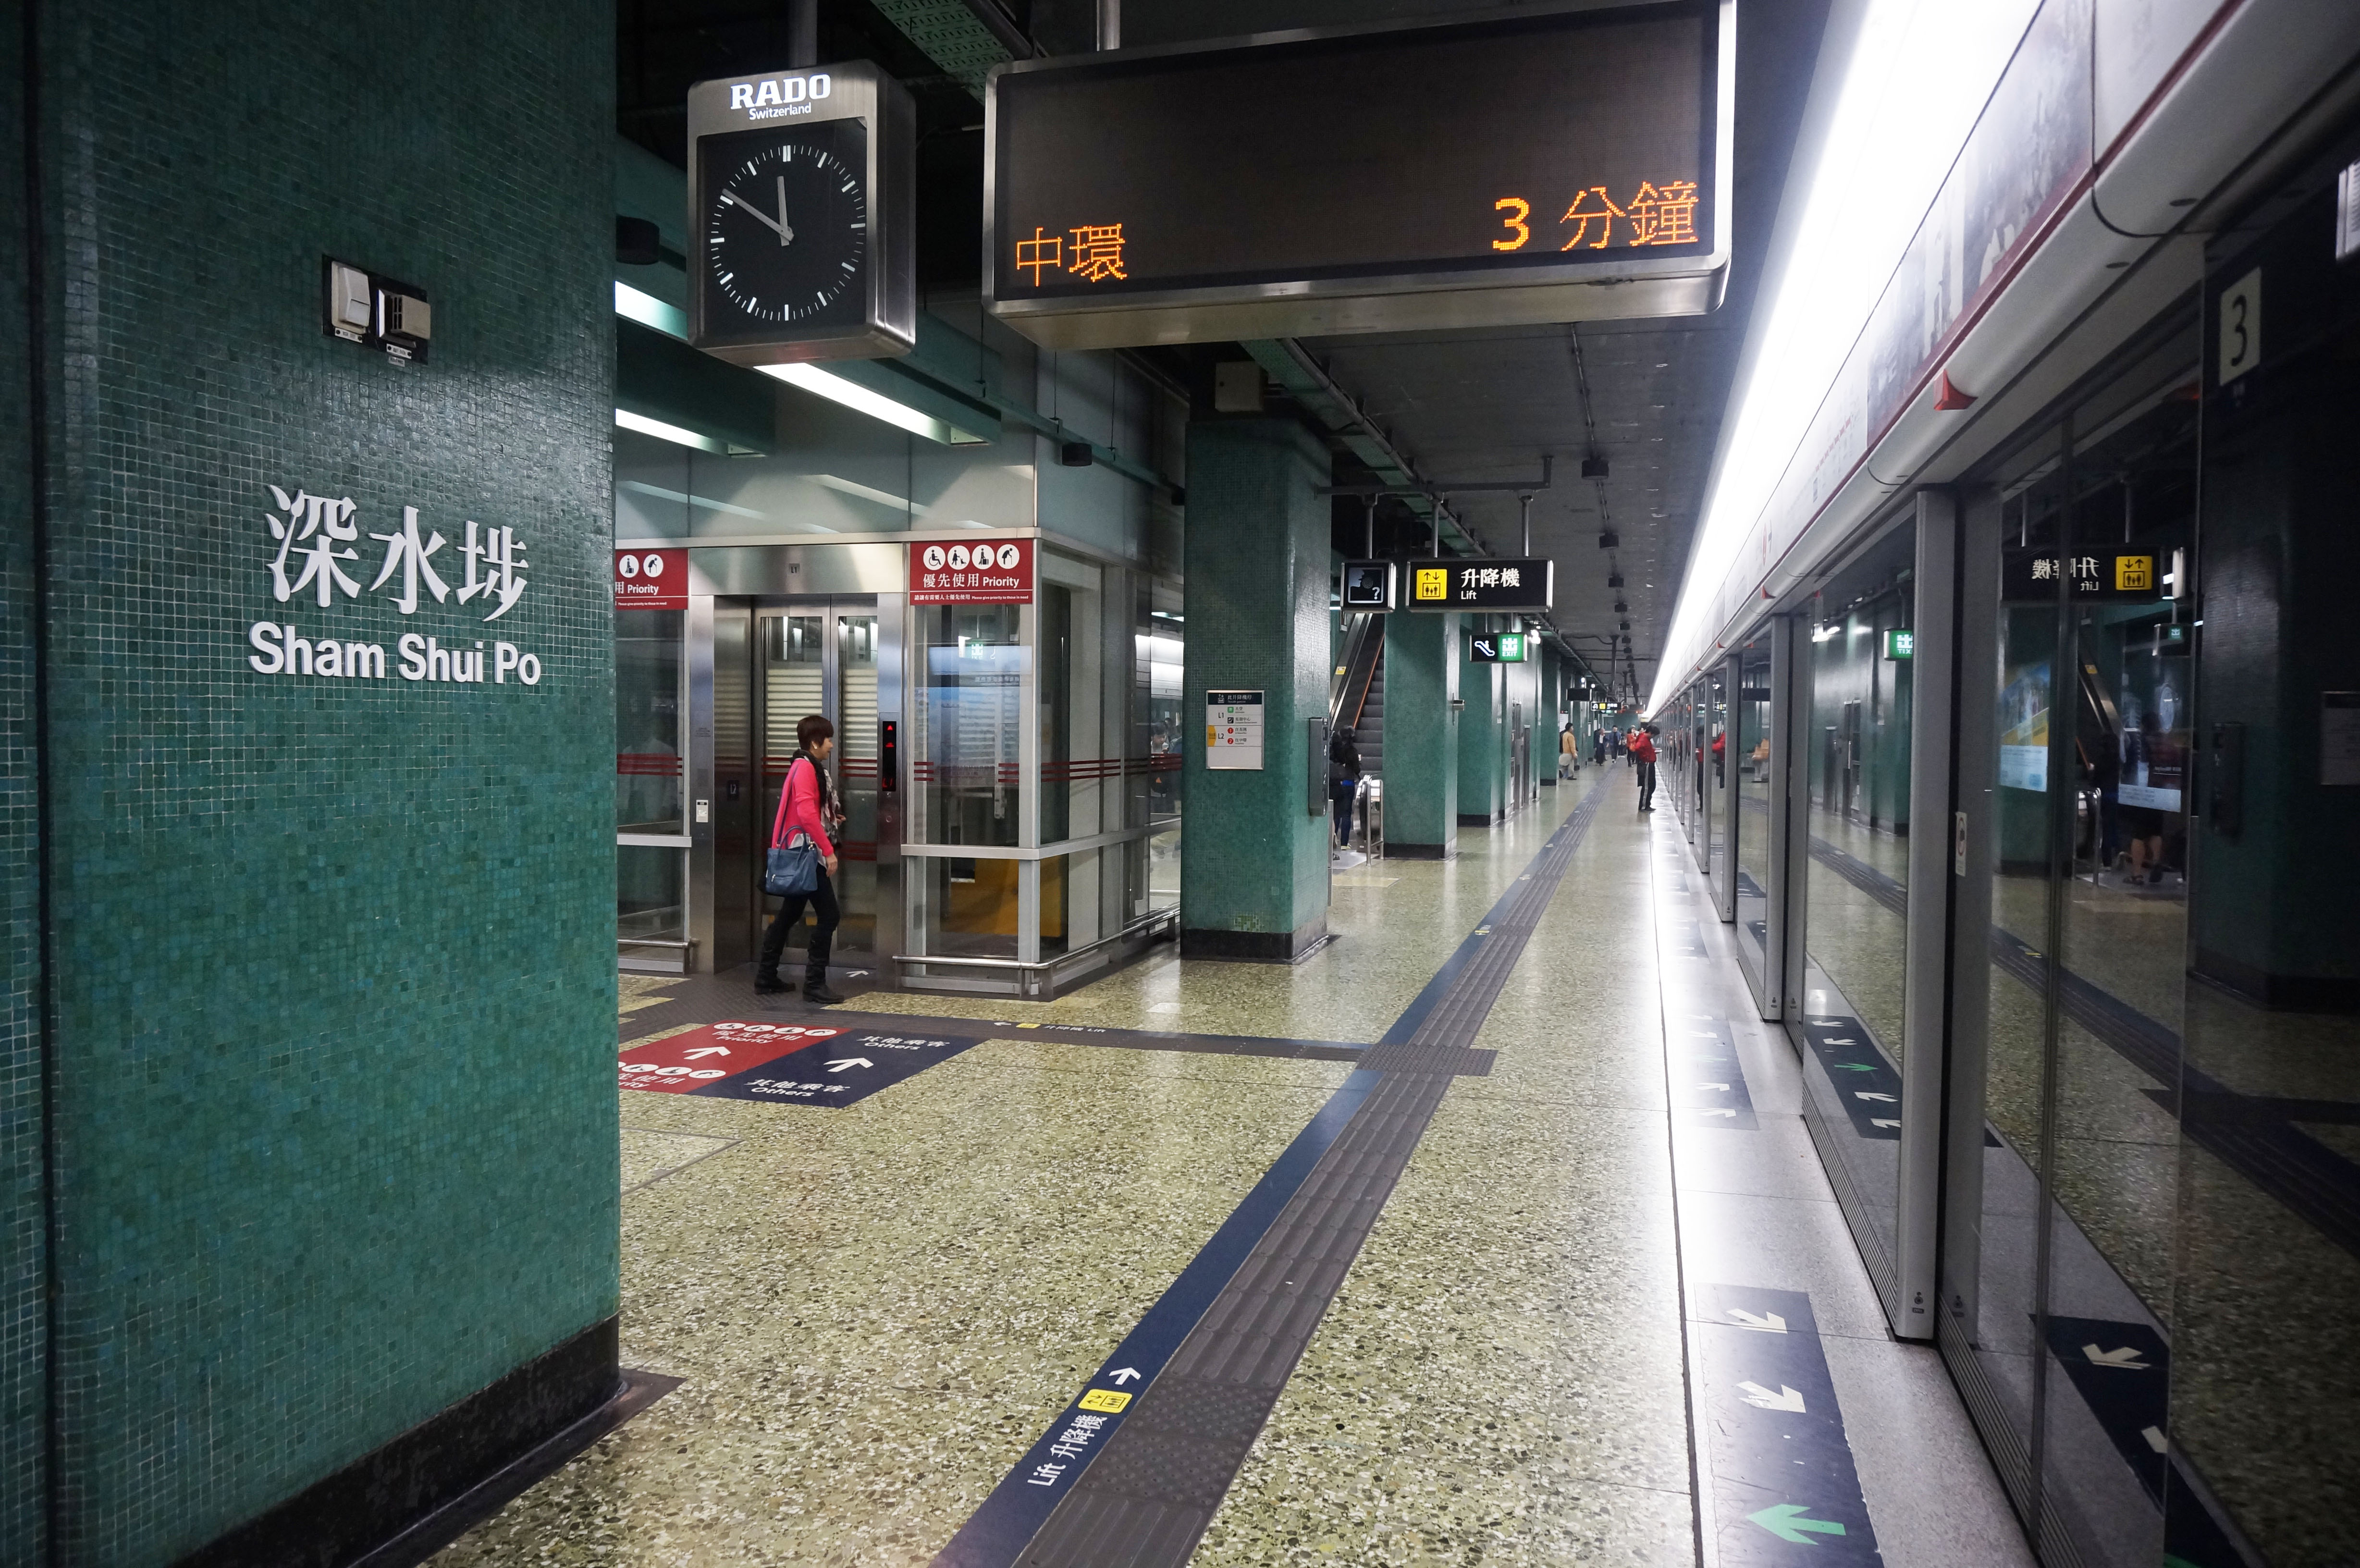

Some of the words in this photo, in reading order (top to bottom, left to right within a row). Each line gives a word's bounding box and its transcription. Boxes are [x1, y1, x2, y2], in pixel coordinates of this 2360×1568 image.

[730, 74, 831, 110] RADO
[749, 102, 811, 121] Switzerland
[1016, 222, 1127, 287] 中環
[1493, 197, 1530, 250] 3
[1560, 181, 1699, 252] 分鐘
[2231, 294, 2248, 368] 3
[264, 484, 529, 622] 深水埗
[923, 573, 980, 588] 優先使用
[983, 576, 1020, 588] Priority
[1460, 567, 1520, 588] 升降機
[627, 584, 659, 596] Priority
[1461, 590, 1477, 600] Lift
[247, 620, 385, 678] Sham
[397, 633, 483, 683] Shui
[494, 641, 541, 686] Po
[716, 1036, 774, 1044] Priority
[864, 1042, 921, 1050] Others
[750, 1087, 815, 1097] Others
[1027, 1462, 1066, 1486] Lift
[1050, 1414, 1108, 1460] 升降機
